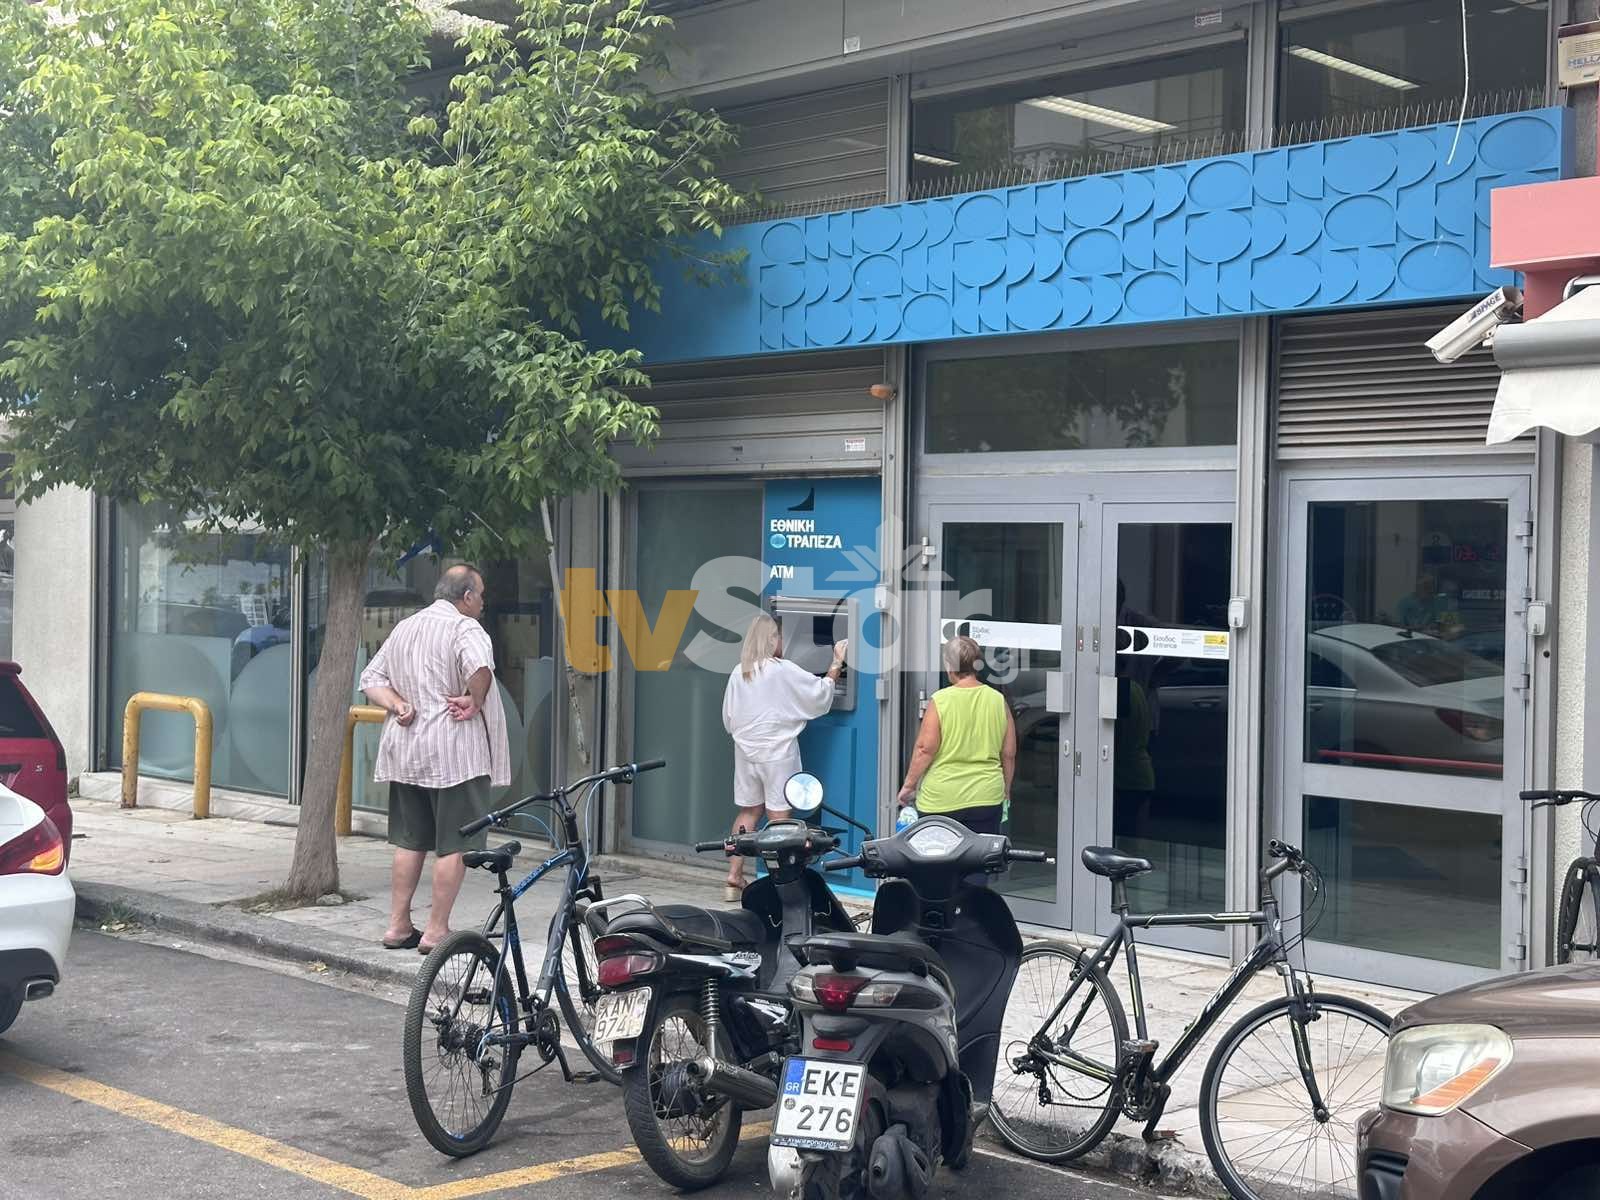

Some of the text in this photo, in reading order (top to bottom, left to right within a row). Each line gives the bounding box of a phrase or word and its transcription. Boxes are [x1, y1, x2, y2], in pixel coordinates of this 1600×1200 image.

[770, 519, 815, 533] ΕΘΝΙΚΗ
[785, 534, 842, 549] ΤΡΑΠΕΖΑ
[769, 564, 794, 579] ATM
[785, 1082, 800, 1092] GR
[803, 1068, 859, 1098] EKE
[796, 1104, 853, 1133] 276
